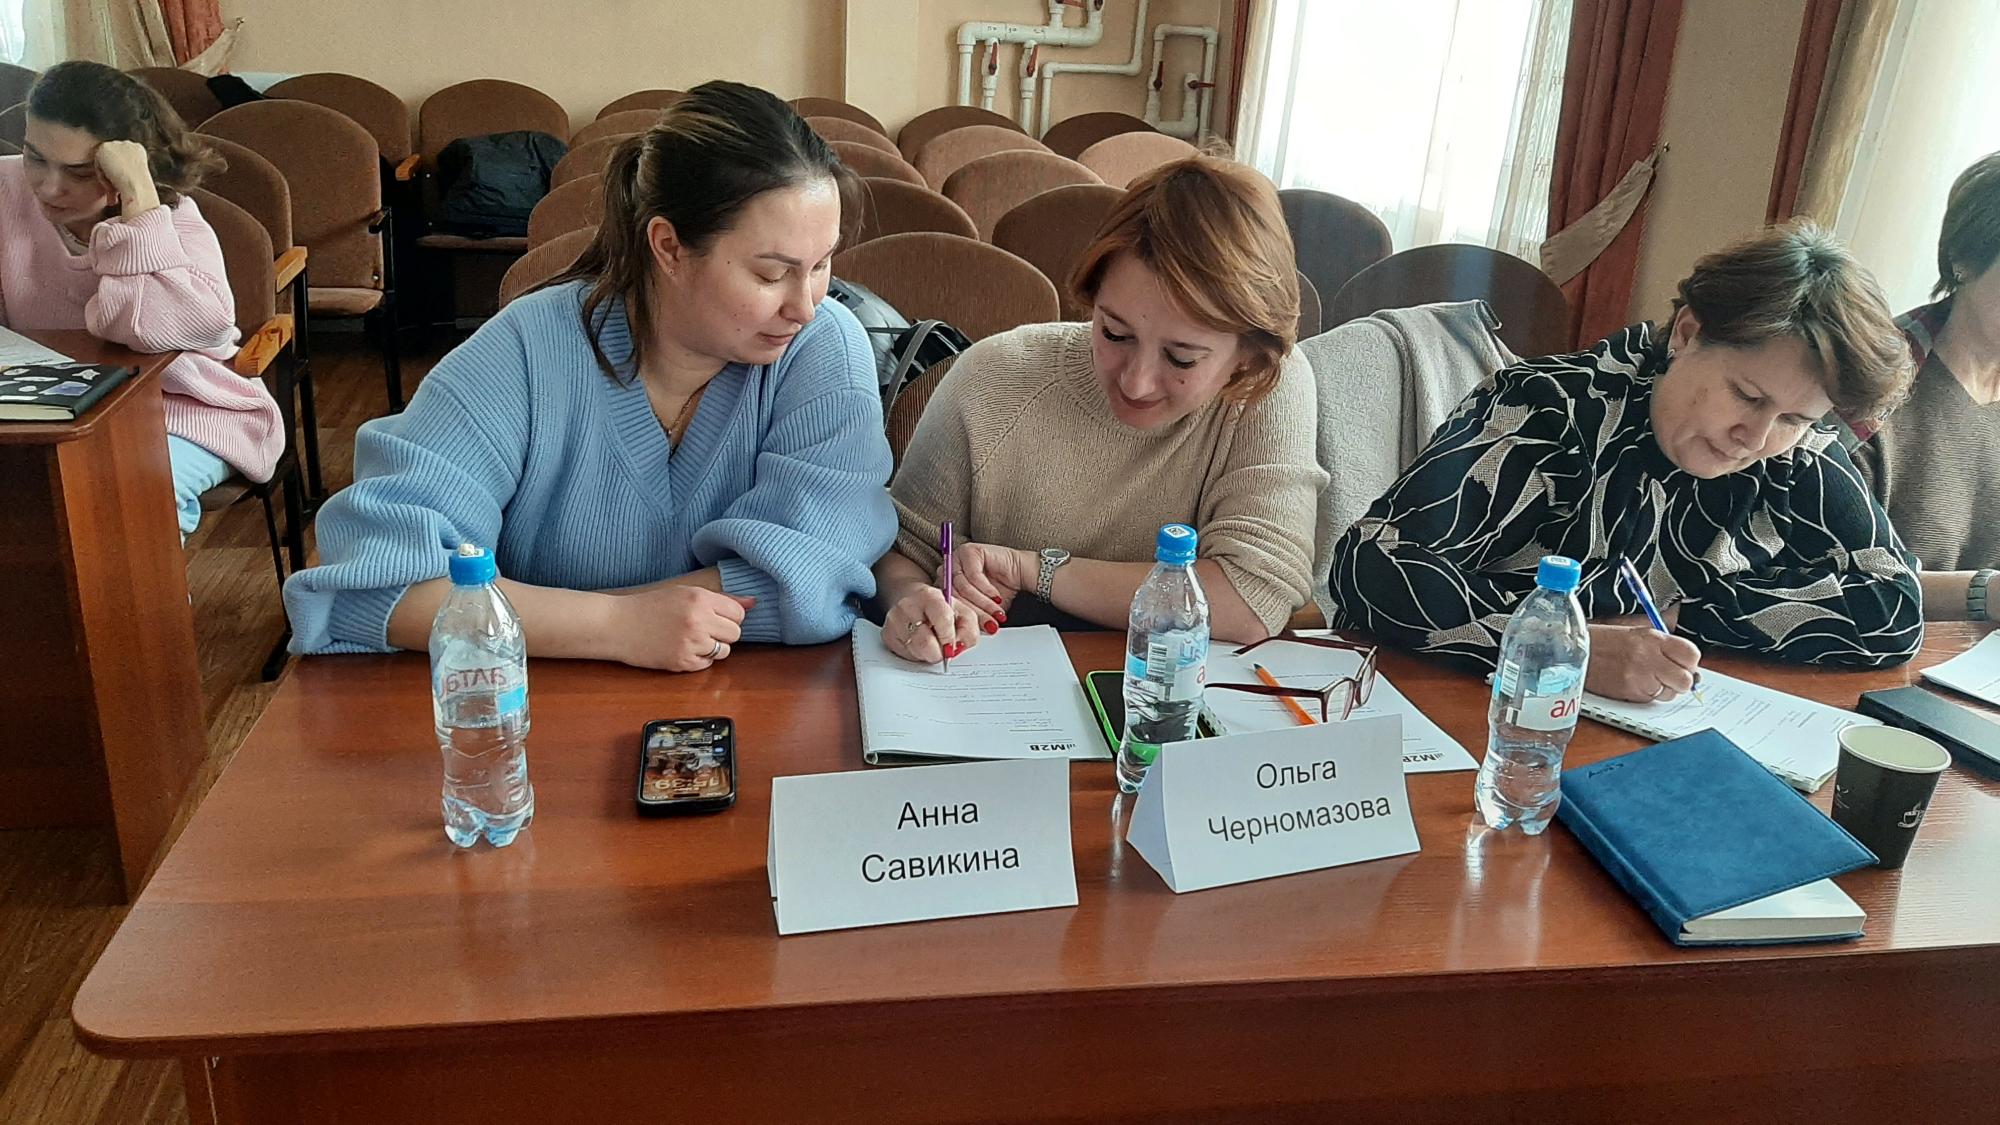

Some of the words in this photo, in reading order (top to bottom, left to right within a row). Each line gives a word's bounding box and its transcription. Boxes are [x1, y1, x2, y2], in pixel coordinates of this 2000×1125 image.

[1030, 743, 1066, 751] M2B
[1256, 760, 1337, 789] Ольга
[897, 801, 979, 830] Анна
[1208, 796, 1391, 844] Черномазова
[861, 847, 1019, 883] Савикина
